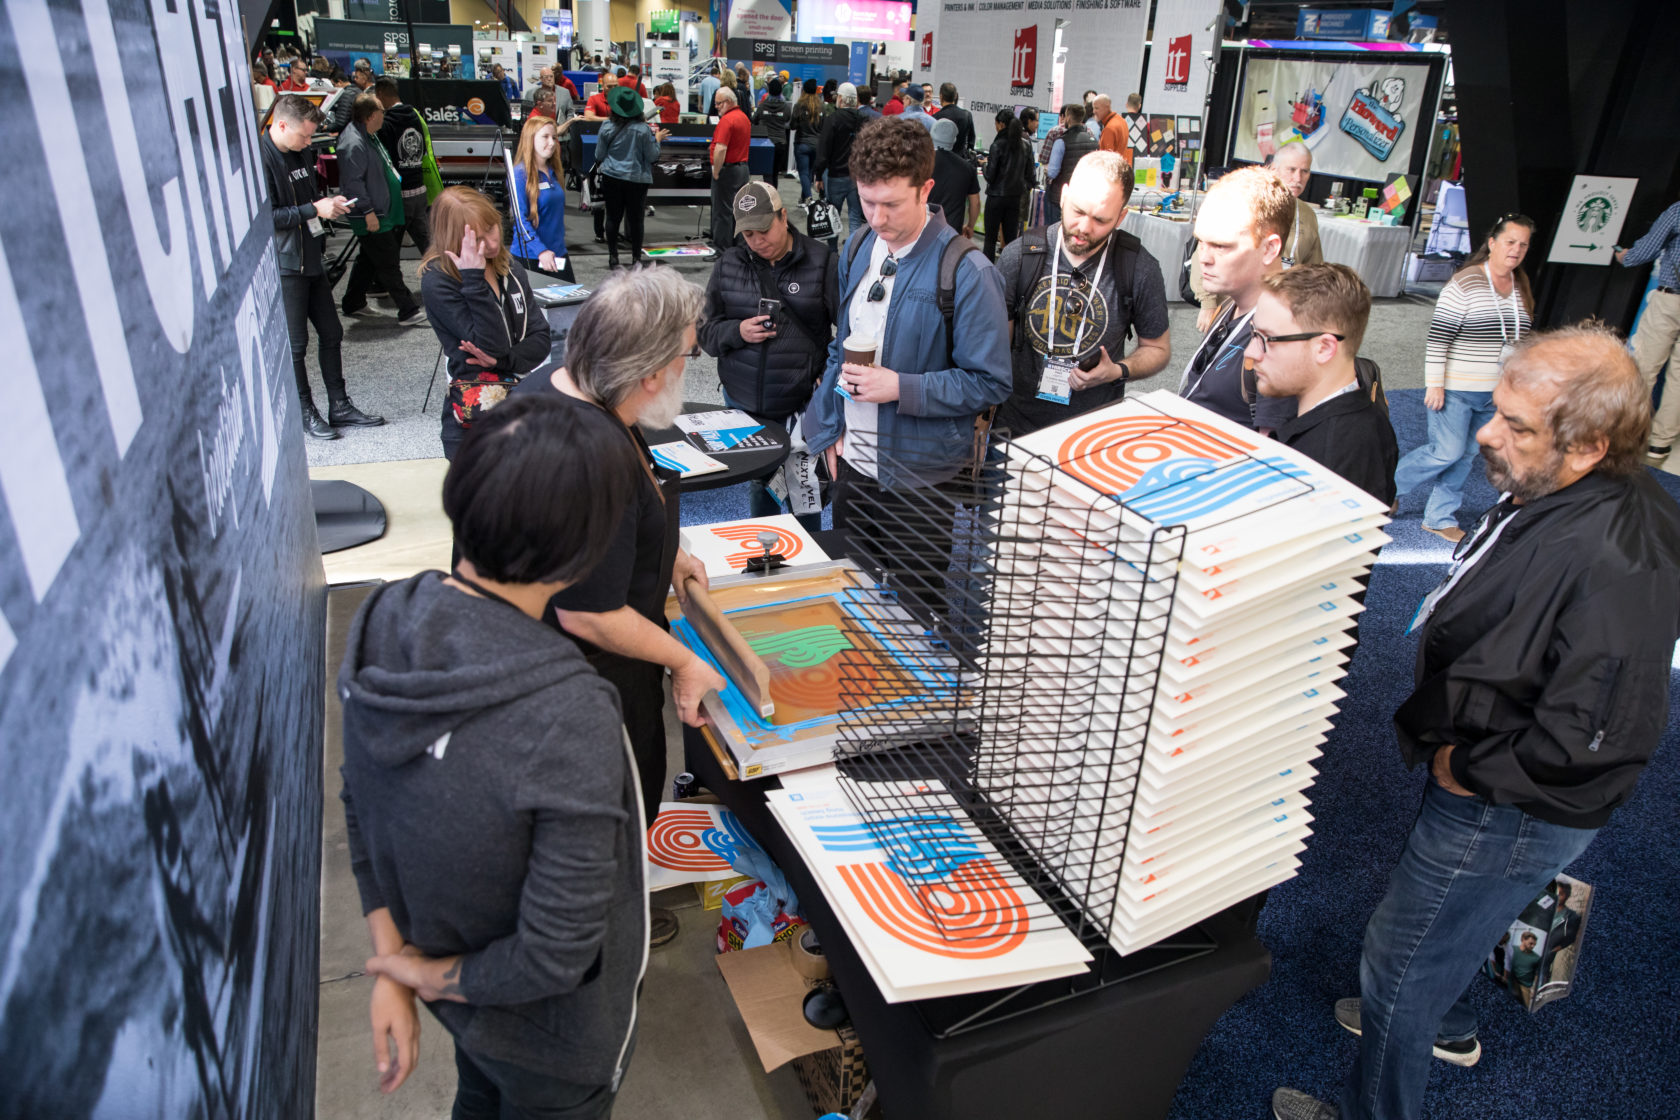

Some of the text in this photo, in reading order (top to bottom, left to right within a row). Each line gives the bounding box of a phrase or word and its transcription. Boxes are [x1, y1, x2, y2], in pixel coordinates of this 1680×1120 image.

[944, 3, 963, 12] PRINTERS
[967, 3, 975, 11] INK
[979, 1, 1025, 11] COLOR MANAGEMENT
[1028, 0, 1072, 10] MEDIA SOLUTIONS
[1075, 0, 1103, 9] FINISHING
[1109, 0, 1141, 9] SOFTWARE
[754, 42, 833, 56] SPSI screen printing
[1012, 28, 1032, 83] it
[1166, 37, 1187, 81] it
[1010, 87, 1034, 98] SUPPLIES
[1164, 83, 1188, 92] SUPPLIES
[424, 107, 460, 122] Sales
[1351, 97, 1399, 141] Howard
[1345, 117, 1390, 149] Personalizer
